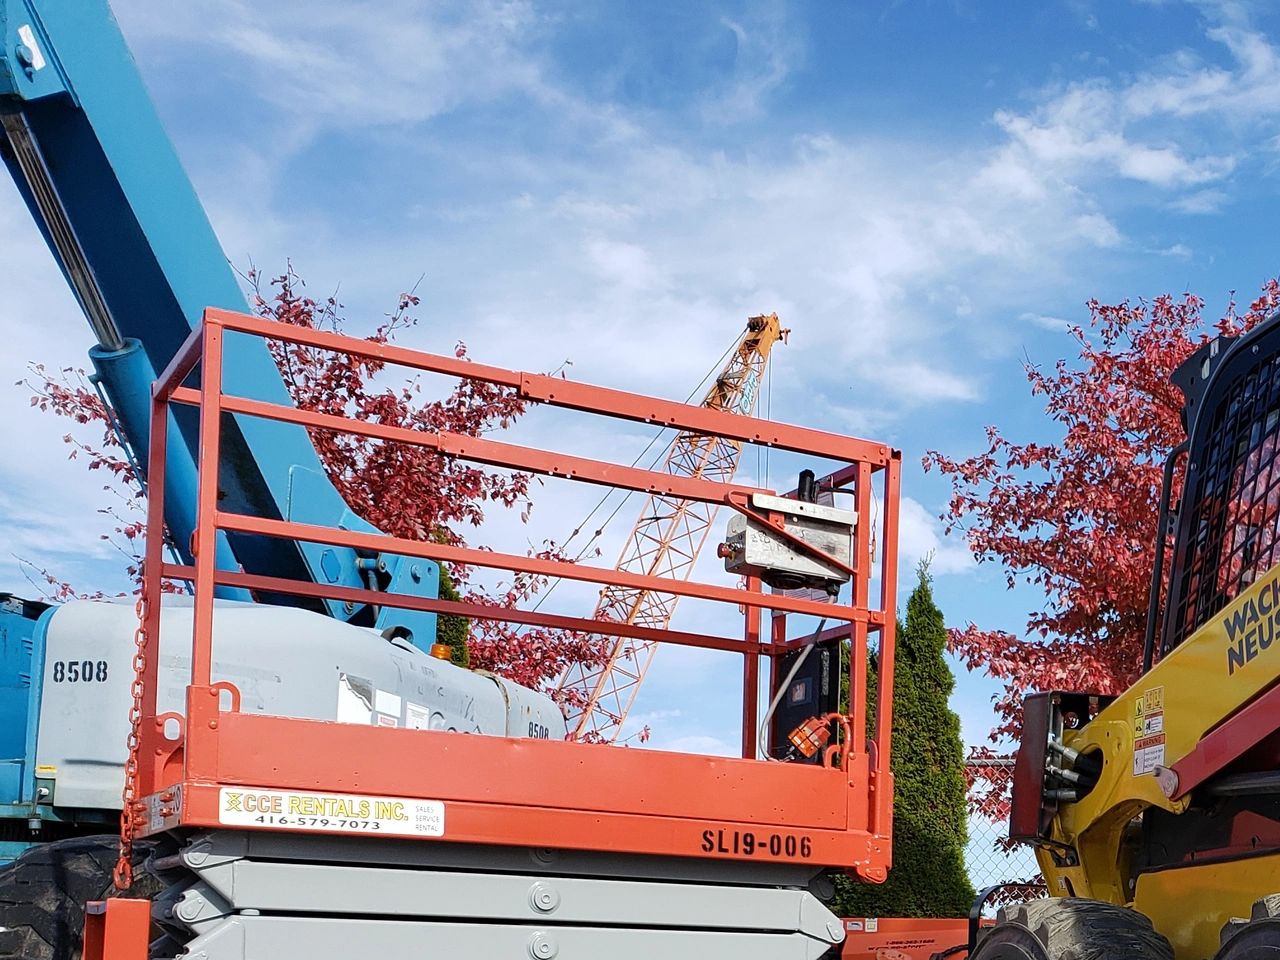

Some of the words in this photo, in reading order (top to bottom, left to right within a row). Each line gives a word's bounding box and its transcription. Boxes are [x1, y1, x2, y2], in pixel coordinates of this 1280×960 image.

[53, 660, 108, 683] 8508
[243, 793, 283, 814] CCE
[288, 795, 370, 819] RENTALS
[374, 802, 410, 822] INC.
[254, 814, 381, 831] 416-579-7073
